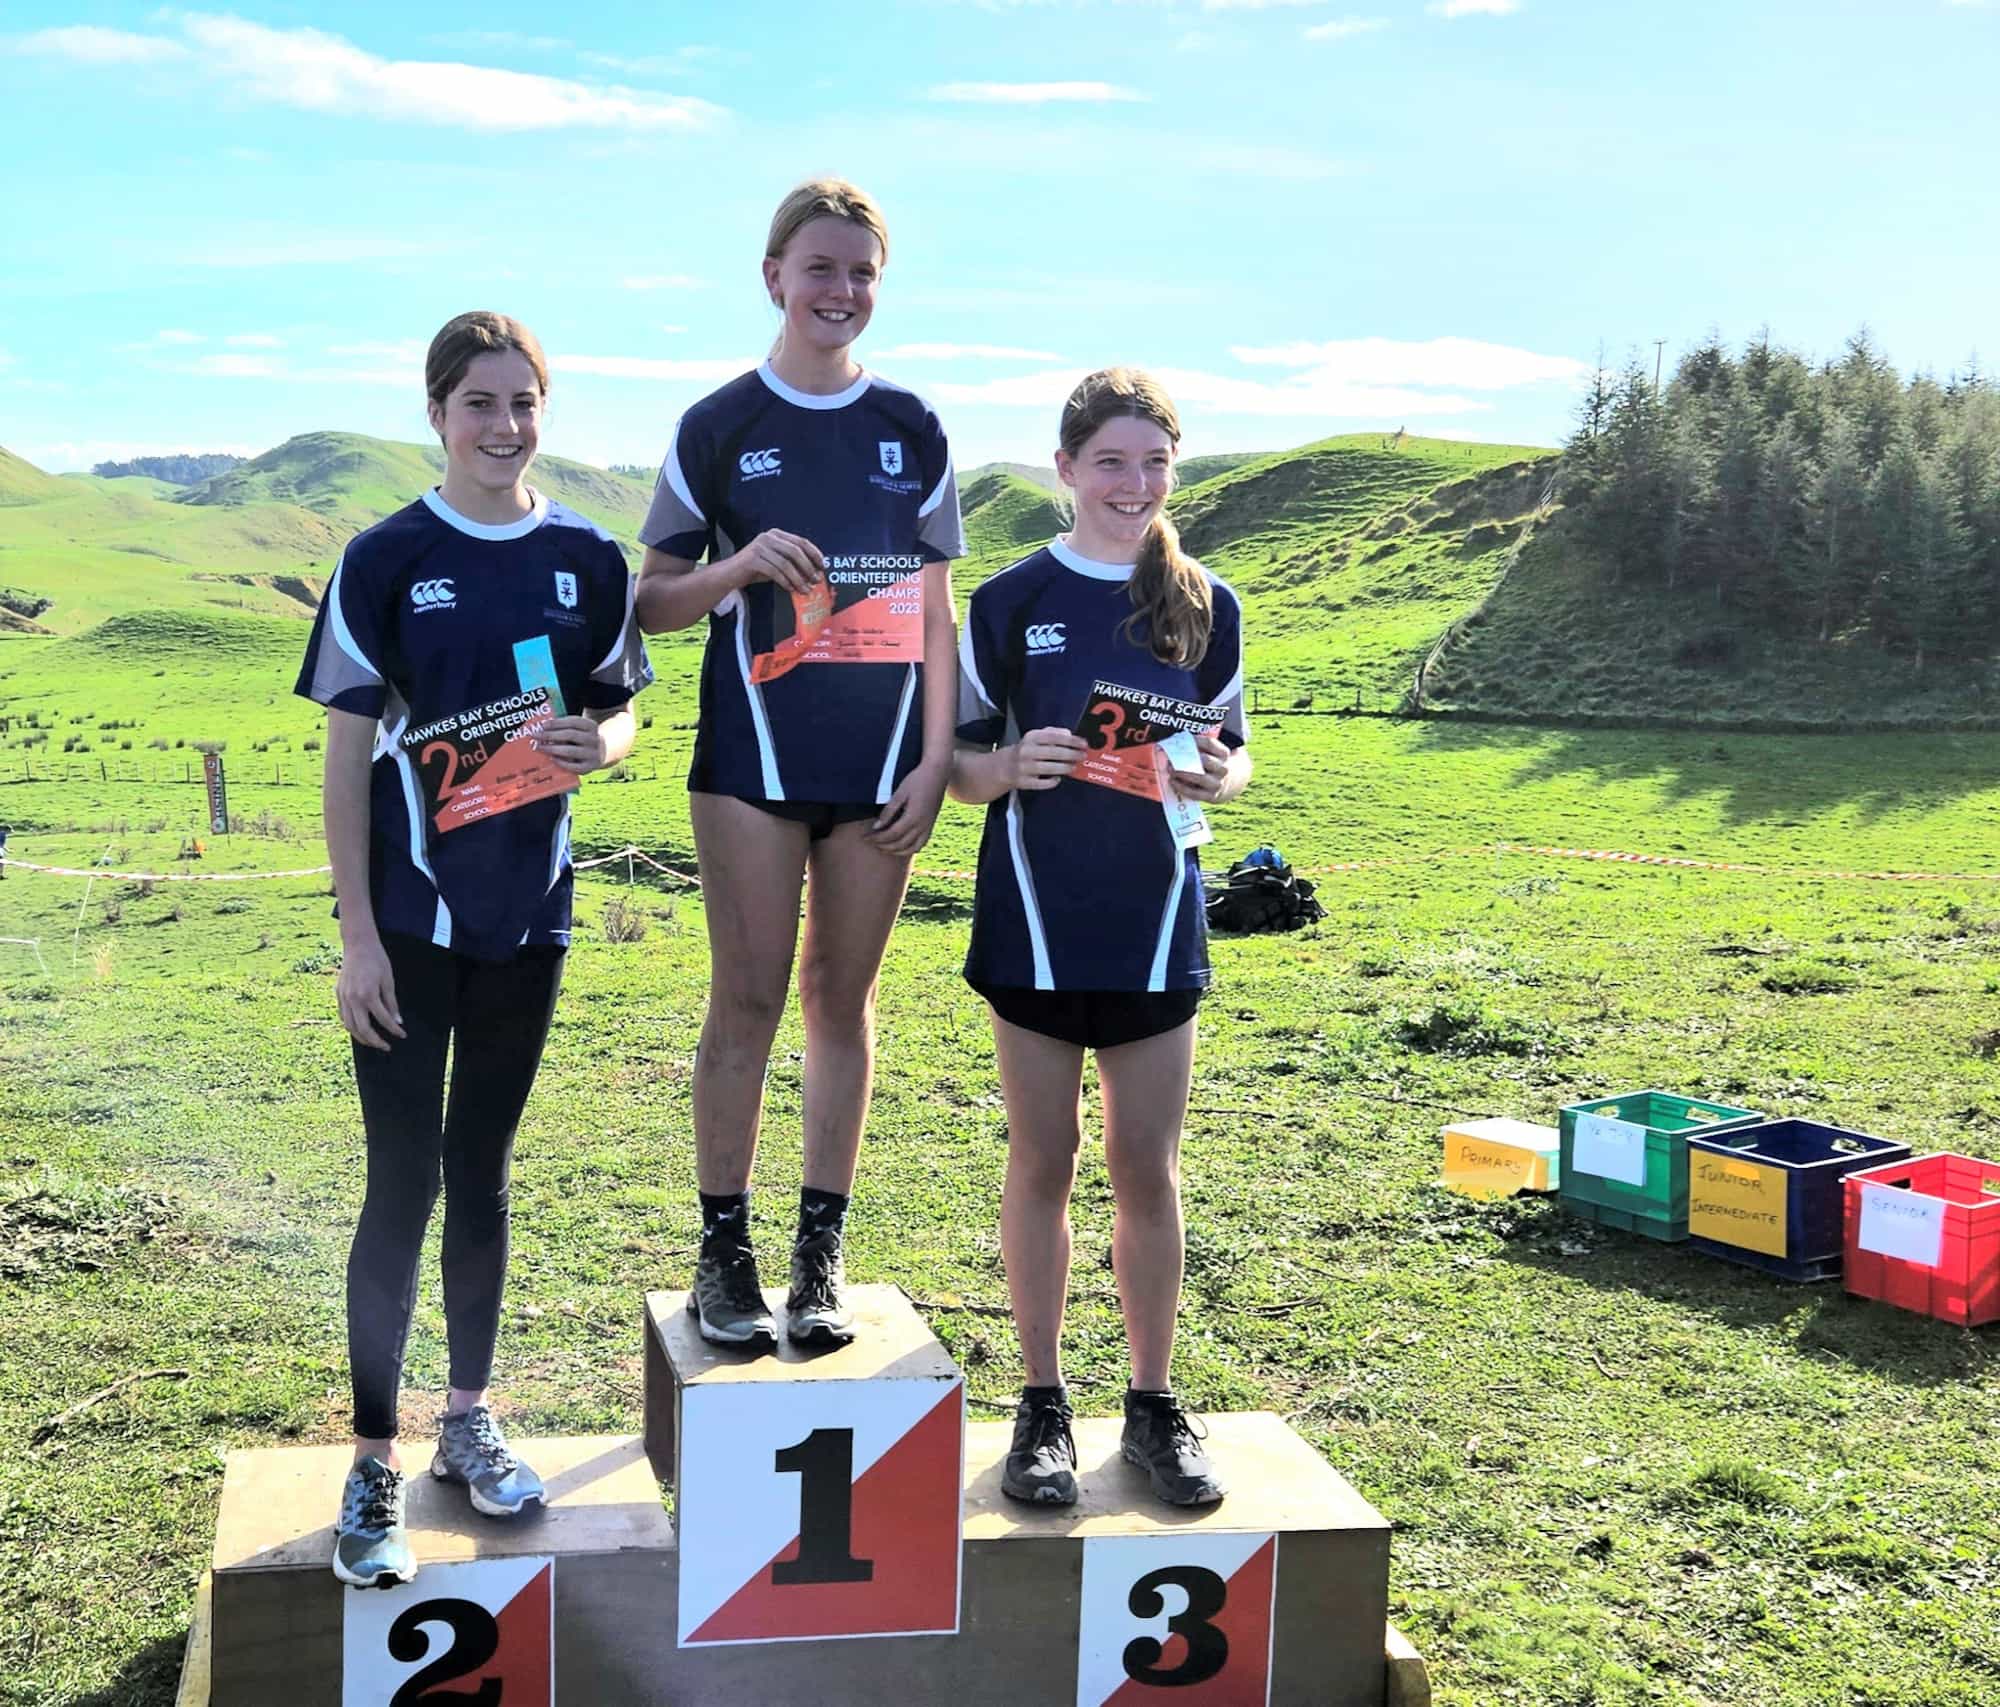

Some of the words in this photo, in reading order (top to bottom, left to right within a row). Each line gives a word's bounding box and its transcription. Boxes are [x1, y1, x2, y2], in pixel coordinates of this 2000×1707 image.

[829, 572, 921, 584] ORIENTEERING
[834, 557, 857, 569] BAY
[860, 556, 922, 569] SCHOOLS
[867, 587, 921, 599] CHAMPS
[889, 602, 921, 614] 2023
[403, 717, 458, 746] HAWKES
[459, 708, 484, 726] BAY
[485, 688, 547, 715] SCHOOLS
[1093, 683, 1148, 705] HAWKES
[1149, 697, 1175, 712] BAY
[460, 703, 551, 741] ORIENTEERING
[1091, 702, 1150, 752] 3rd
[421, 740, 489, 800] 2nd
[771, 1428, 873, 1585] 1
[1122, 1565, 1227, 1688] 3
[387, 1597, 504, 1707] 2
